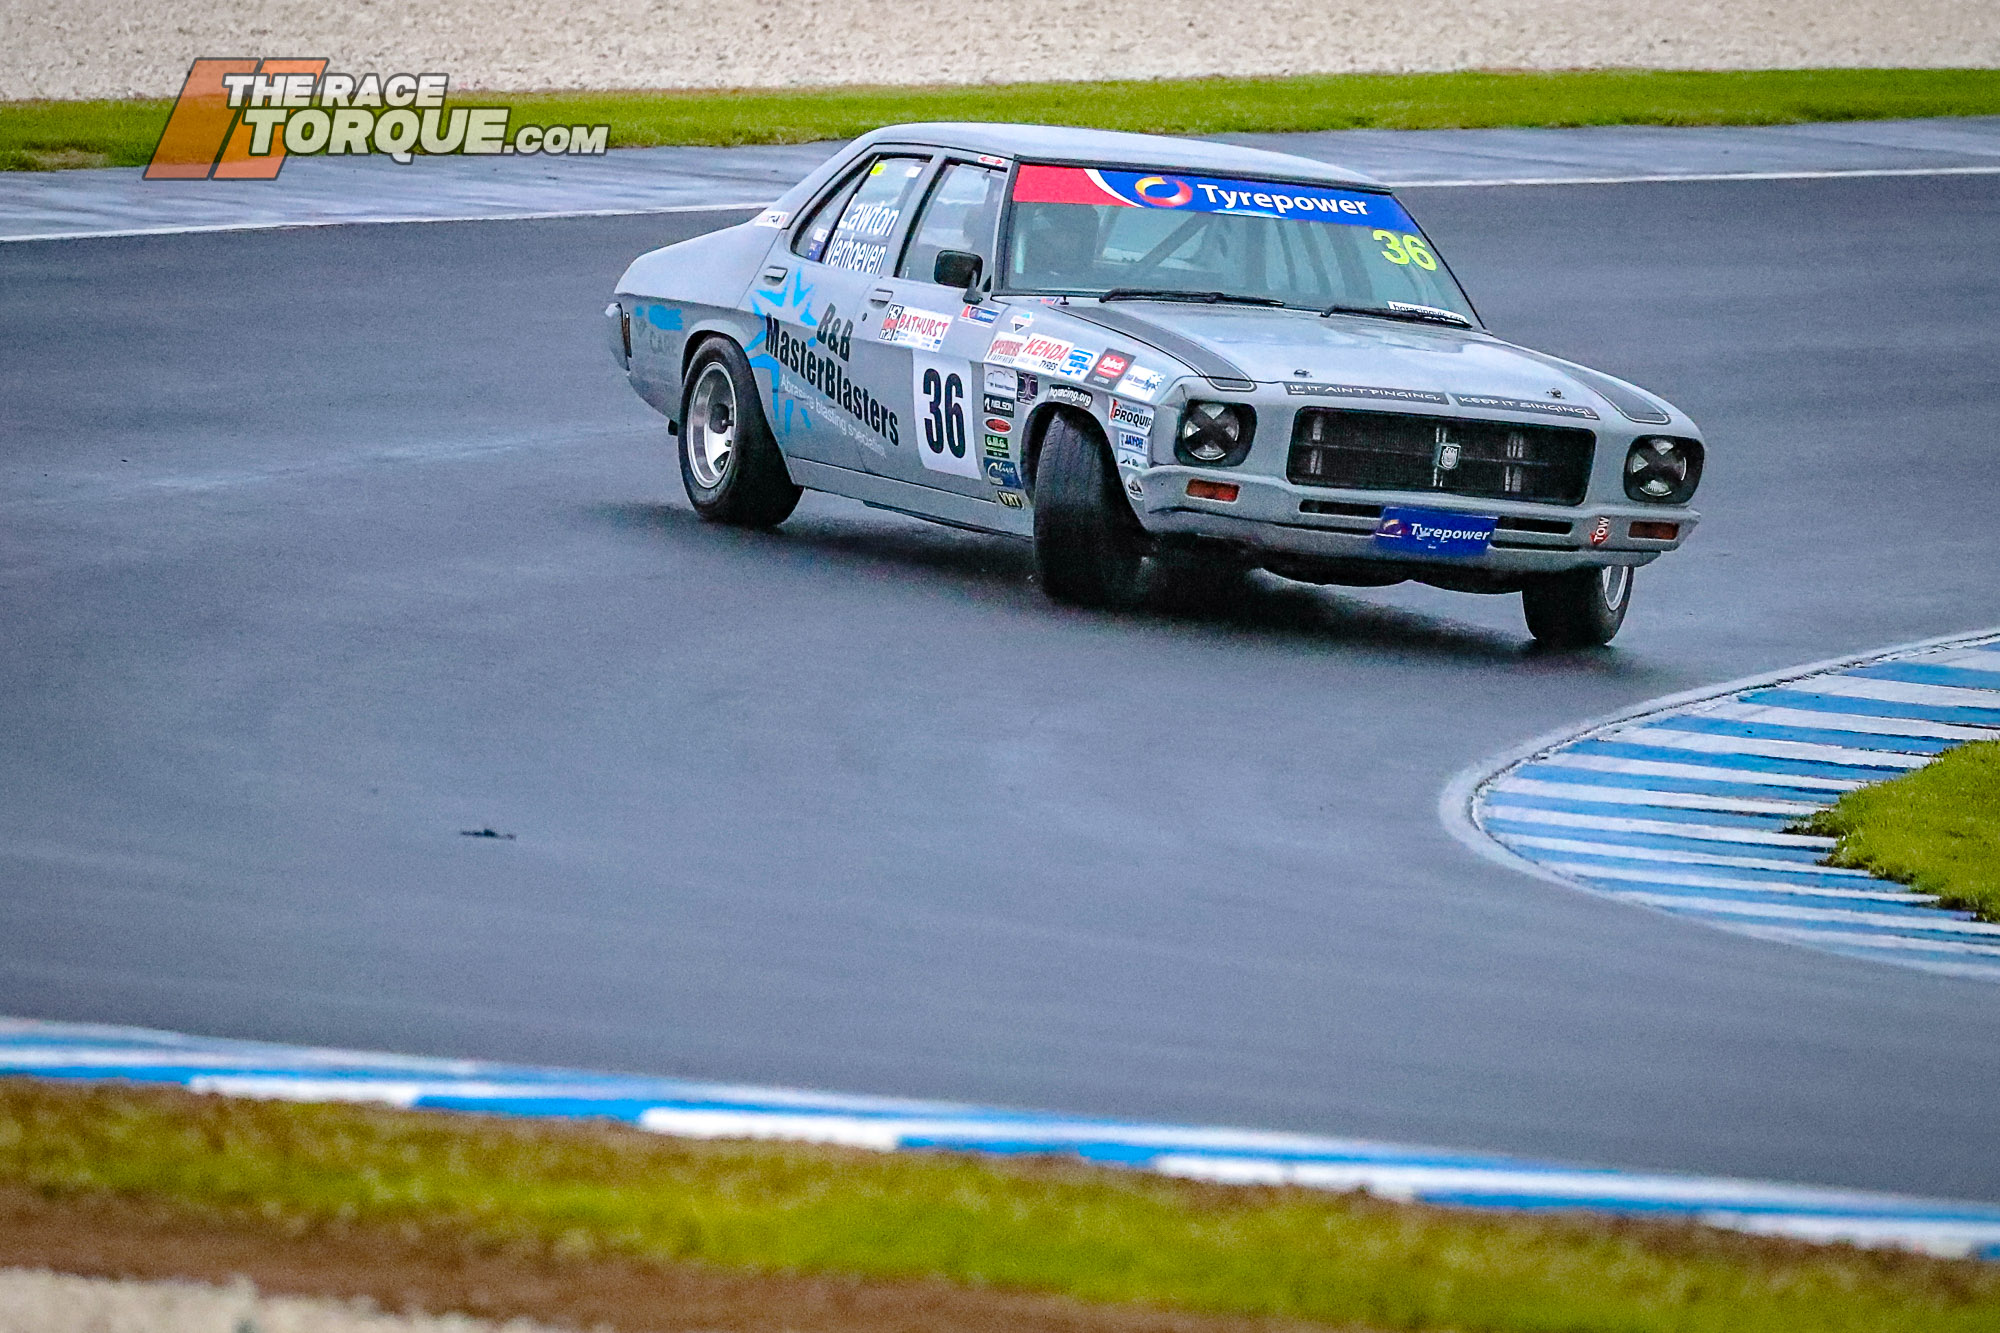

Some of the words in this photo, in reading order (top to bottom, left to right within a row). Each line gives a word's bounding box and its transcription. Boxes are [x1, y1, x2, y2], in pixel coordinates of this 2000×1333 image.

[1197, 183, 1368, 215] Tyrepower
[838, 193, 899, 236] Lawton
[1373, 229, 1437, 271] 36
[817, 303, 854, 361] B&B
[898, 313, 949, 338] BATHURST
[1023, 338, 1069, 361] KENDA
[765, 311, 900, 446] MasterBlasters
[1290, 384, 1302, 392] IF
[1325, 386, 1368, 395] AIN'T
[923, 368, 966, 459] 36
[1459, 396, 1499, 405] KEEP
[1502, 399, 1515, 407] IT
[1411, 523, 1490, 543] Tyrepower
[1594, 516, 1610, 542] TOW
